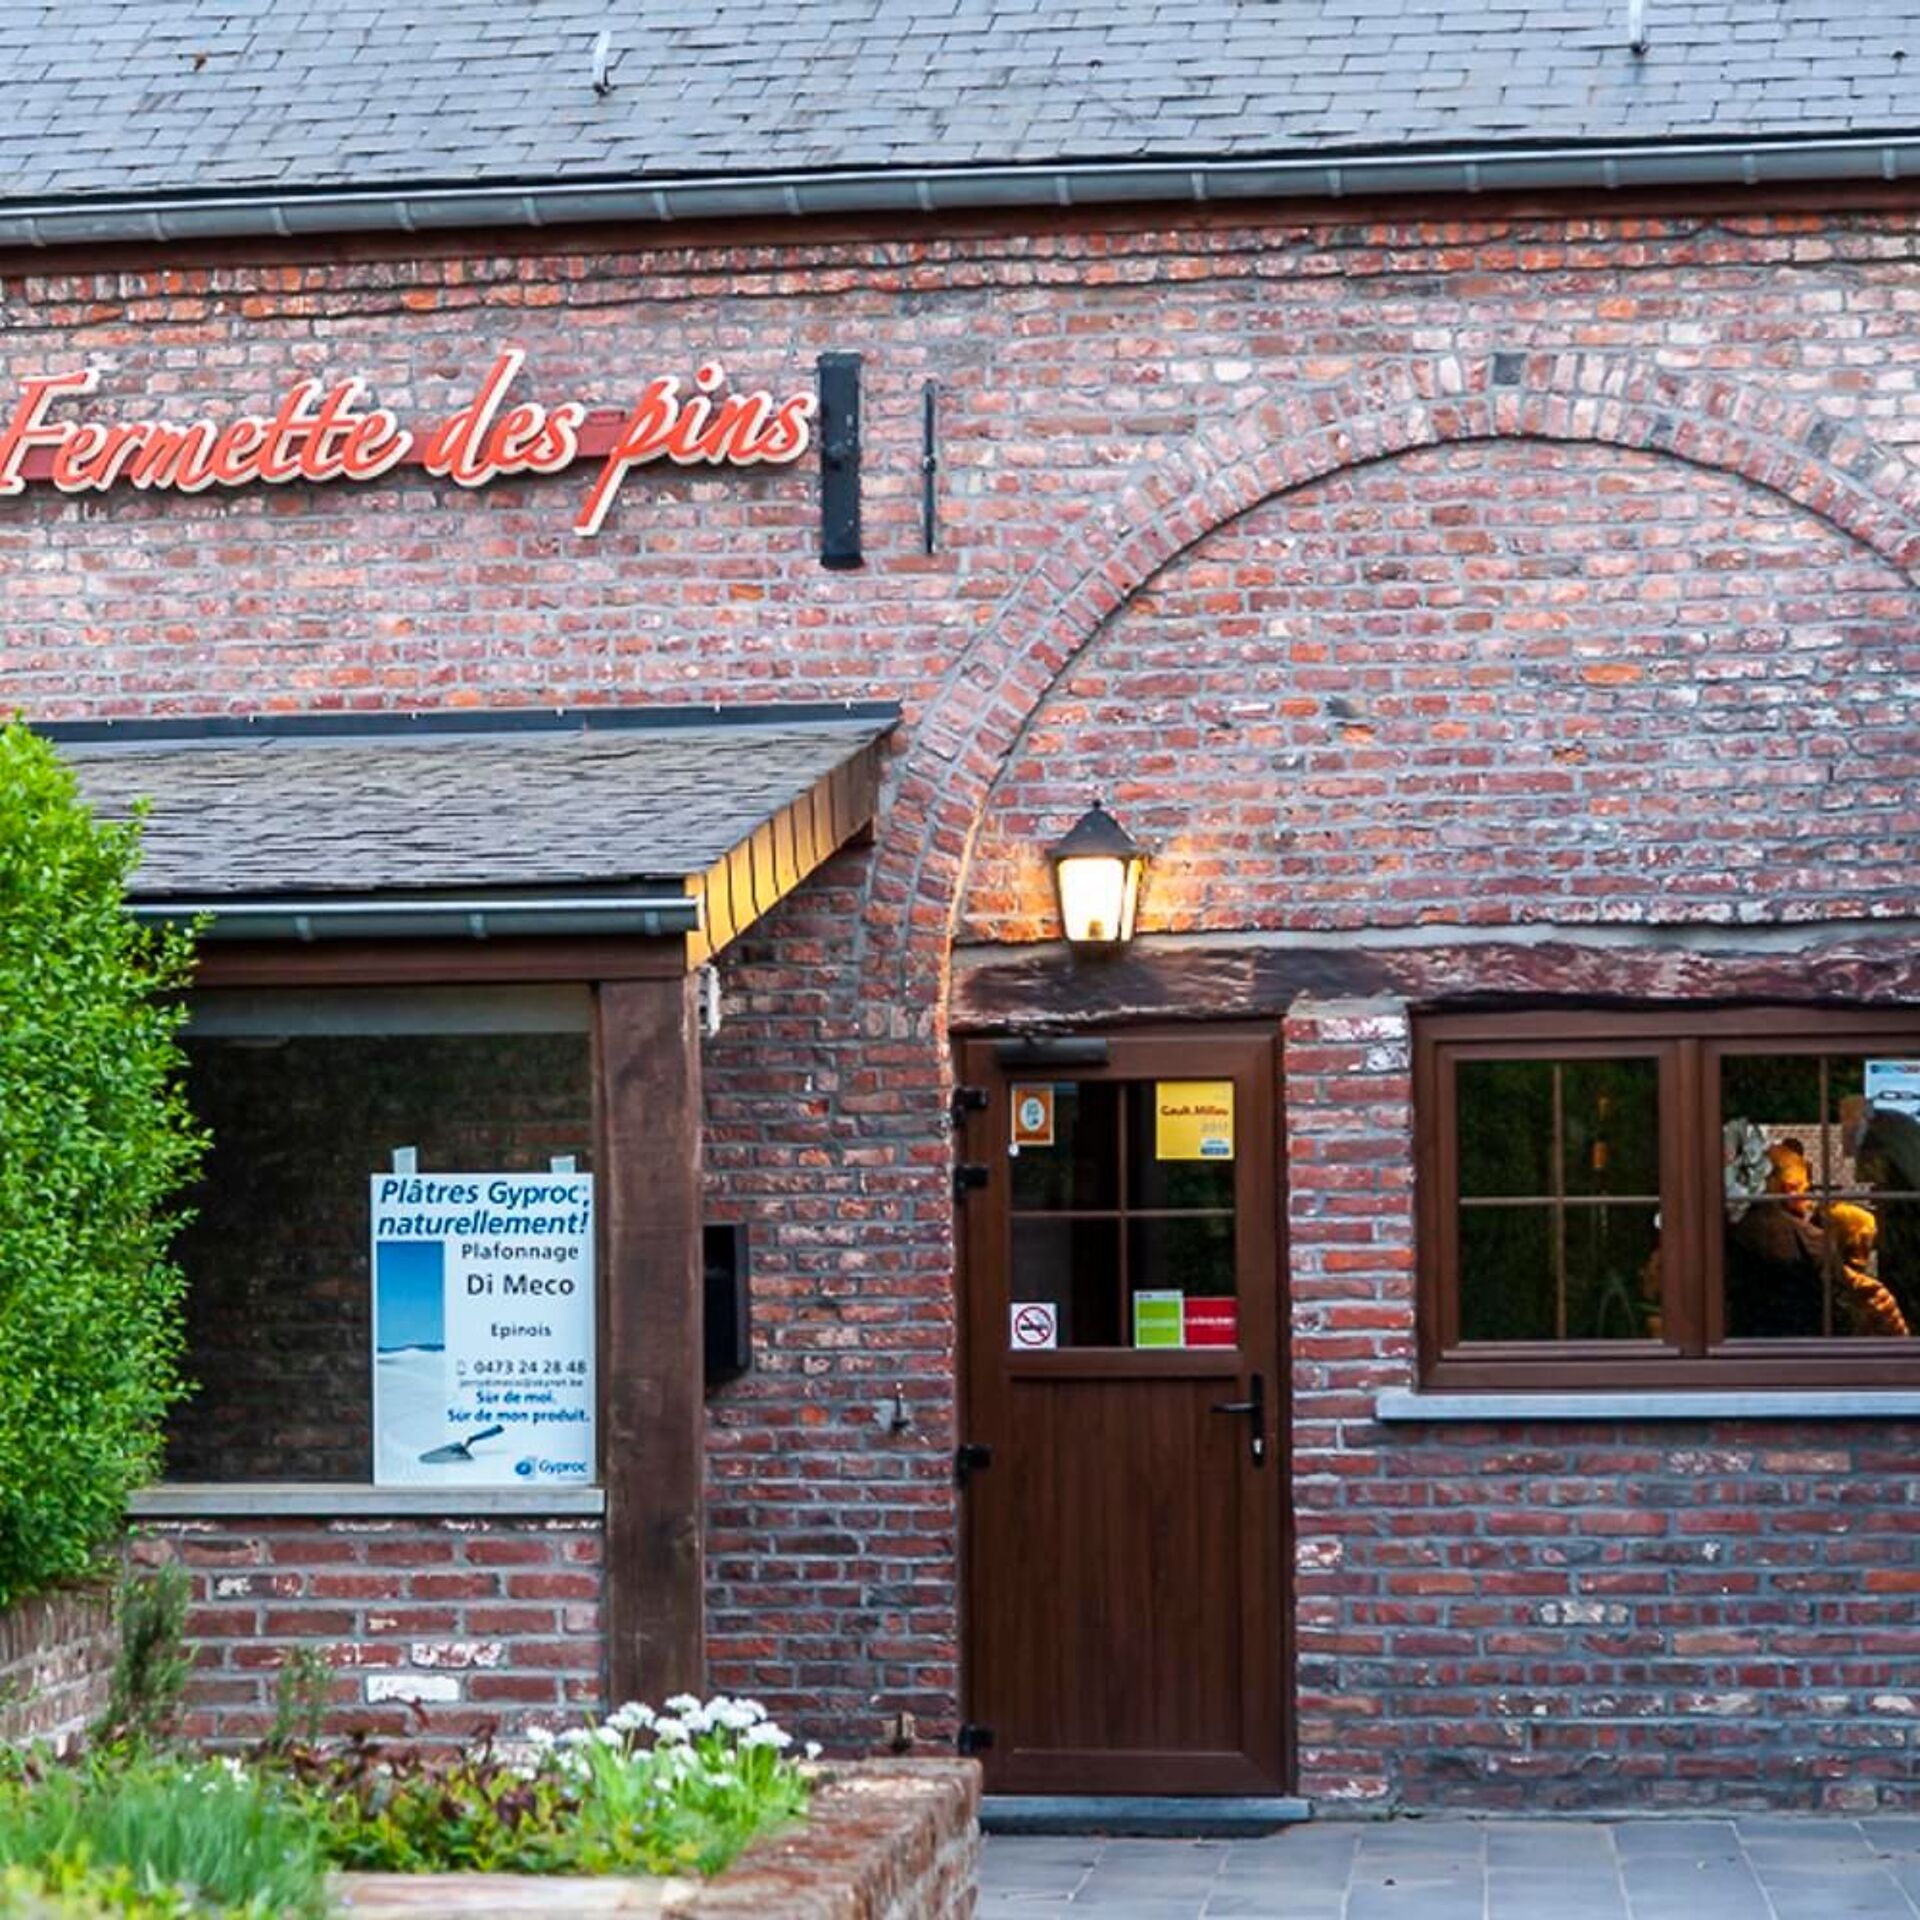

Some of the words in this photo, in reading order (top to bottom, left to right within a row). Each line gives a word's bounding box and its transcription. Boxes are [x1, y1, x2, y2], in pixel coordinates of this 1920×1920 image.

[0, 368, 412, 494] Fermette
[425, 349, 584, 488] des
[572, 362, 816, 536] pins
[380, 1179, 479, 1205] Plâtres
[377, 1210, 590, 1236] naturellement!
[461, 1243, 579, 1263] Plafonnage
[466, 1273, 493, 1296] Di
[503, 1274, 576, 1296] Meco
[490, 1322, 552, 1339] Epinois
[473, 1359, 514, 1375] 0473
[519, 1359, 538, 1375] 24
[504, 1390, 521, 1403] de
[474, 1408, 493, 1422] de
[497, 1411, 529, 1422] mon
[538, 1459, 587, 1475] Gyproc
